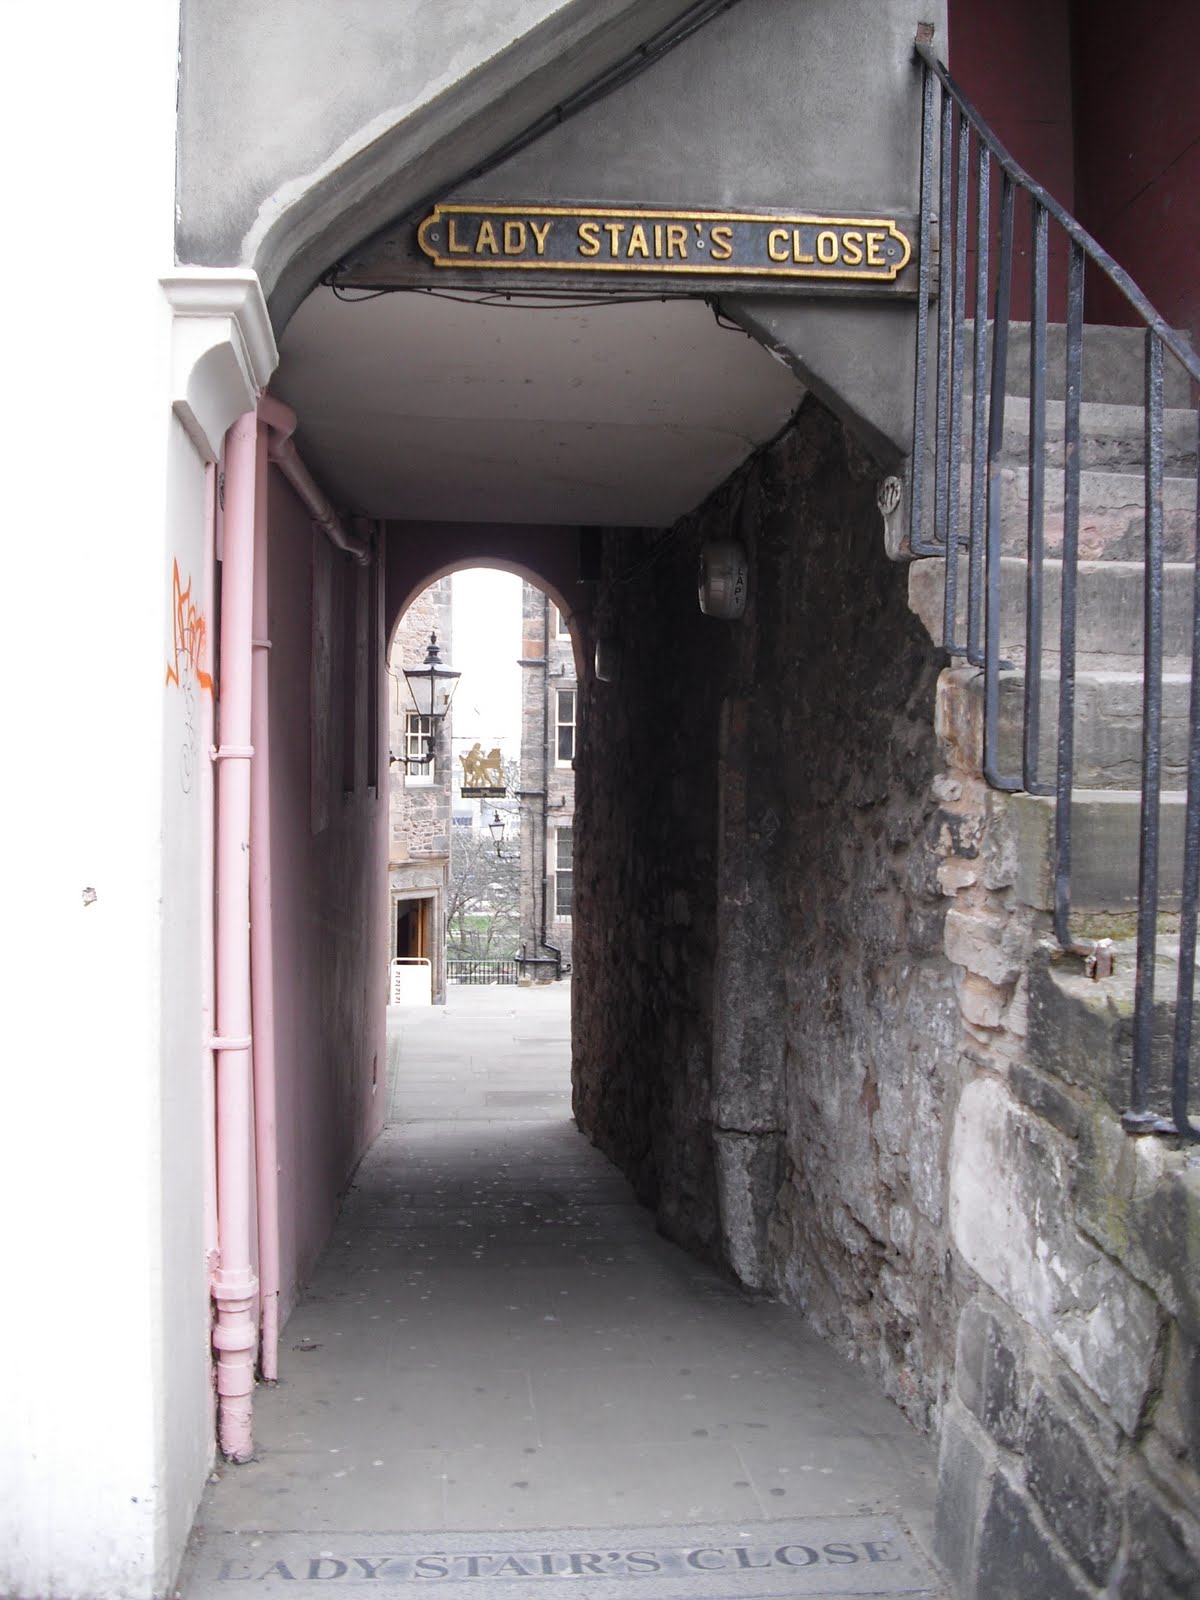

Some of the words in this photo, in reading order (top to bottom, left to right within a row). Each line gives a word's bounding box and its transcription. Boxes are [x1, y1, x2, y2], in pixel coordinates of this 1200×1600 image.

[447, 221, 552, 256] LADY
[578, 222, 733, 260] STAIR'S
[767, 228, 887, 266] CLOSE
[218, 1556, 393, 1581] LADY
[414, 1550, 661, 1579] STAIR'S
[686, 1541, 903, 1571] CLOSE
